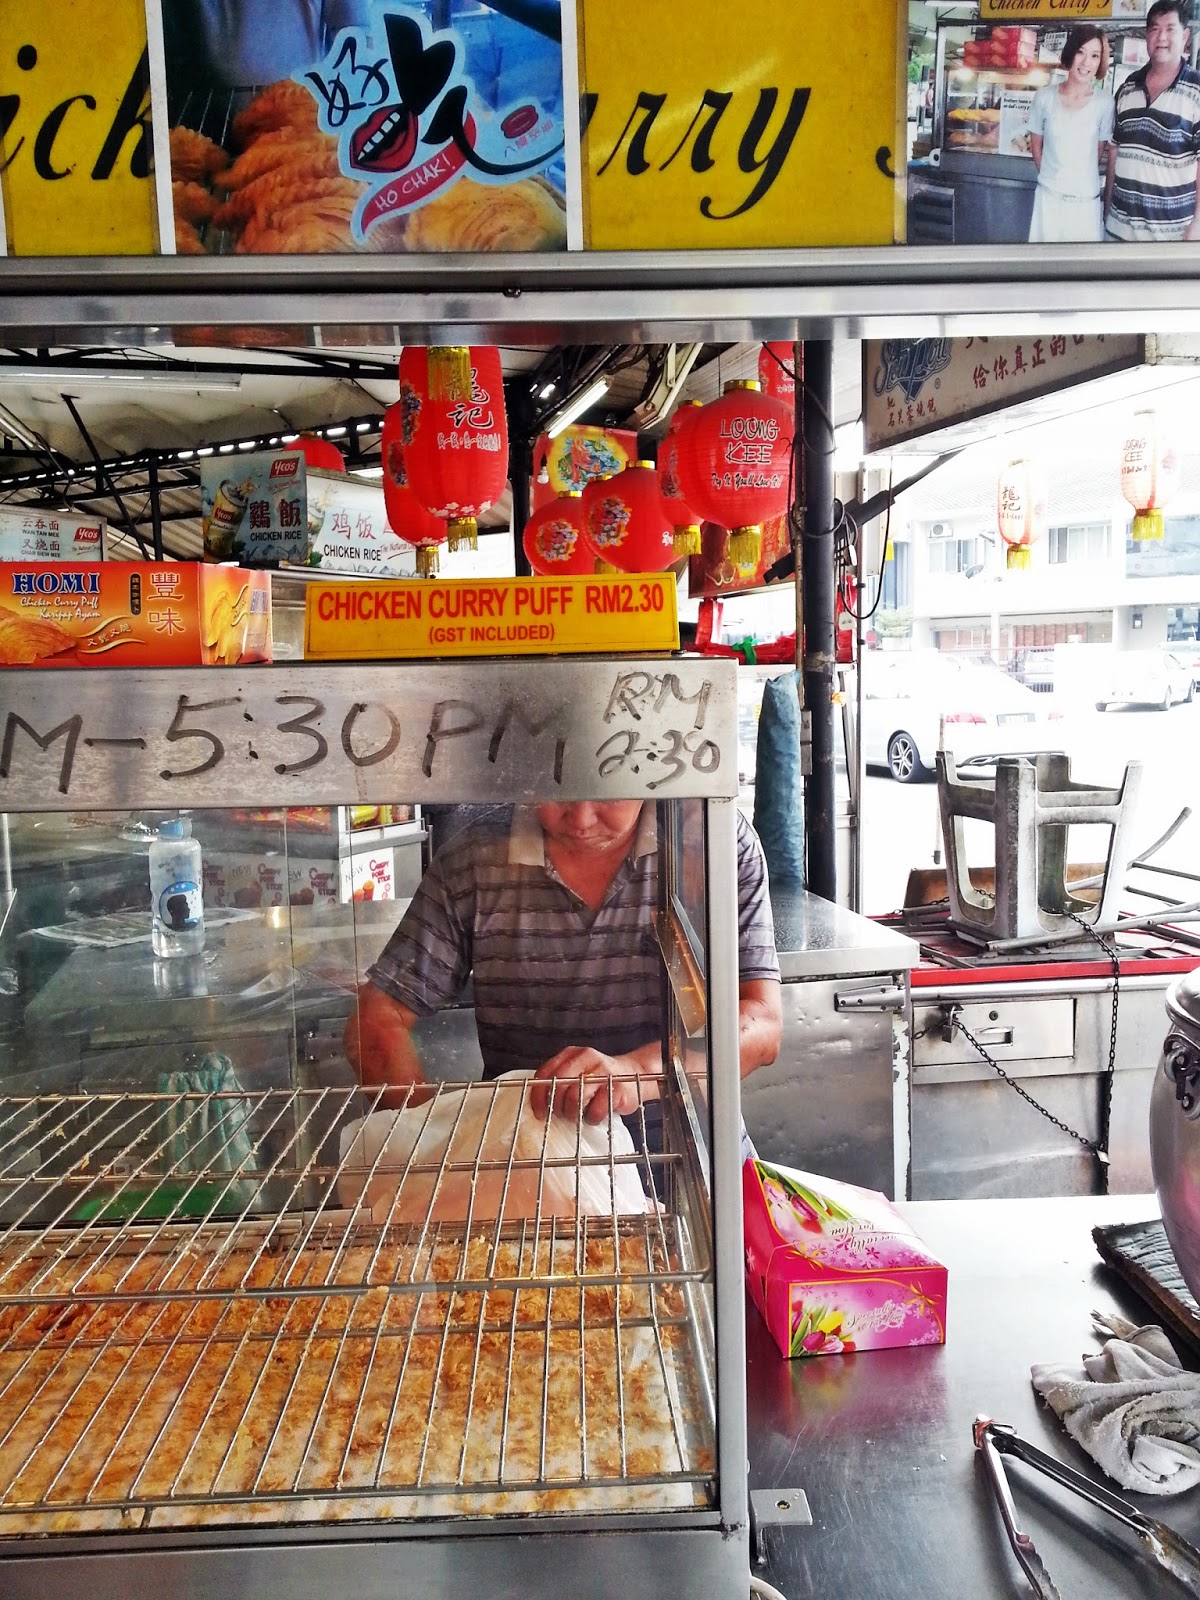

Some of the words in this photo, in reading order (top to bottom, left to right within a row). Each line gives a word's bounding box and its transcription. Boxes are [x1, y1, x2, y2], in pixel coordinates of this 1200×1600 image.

[375, 189, 398, 211] HO
[402, 153, 456, 194] CHAK!
[720, 417, 780, 441] LOONG
[726, 442, 773, 465] KEE
[274, 461, 296, 474] Yeo's
[22, 518, 59, 531] 云吞面
[332, 509, 376, 539] 鸡饭
[79, 529, 98, 539] Yeo's
[250, 532, 282, 541] CHICKEN
[284, 531, 301, 540] RICE
[324, 544, 360, 559] CHICKEN
[364, 548, 381, 561] RICE
[12, 572, 100, 594] HOMI
[20, 596, 51, 607] Chicken
[54, 597, 79, 609] Curry
[81, 596, 98, 609] Puff
[147, 572, 186, 635] 豐味
[318, 591, 421, 621] CHICKEN
[428, 588, 508, 618] CURRY
[515, 586, 573, 615] PUFF
[586, 583, 664, 613] RM2.30
[75, 607, 101, 622] Ayam
[429, 627, 457, 645] (GST
[470, 623, 555, 642] INCLUDED)
[289, 870, 301, 878] EW
